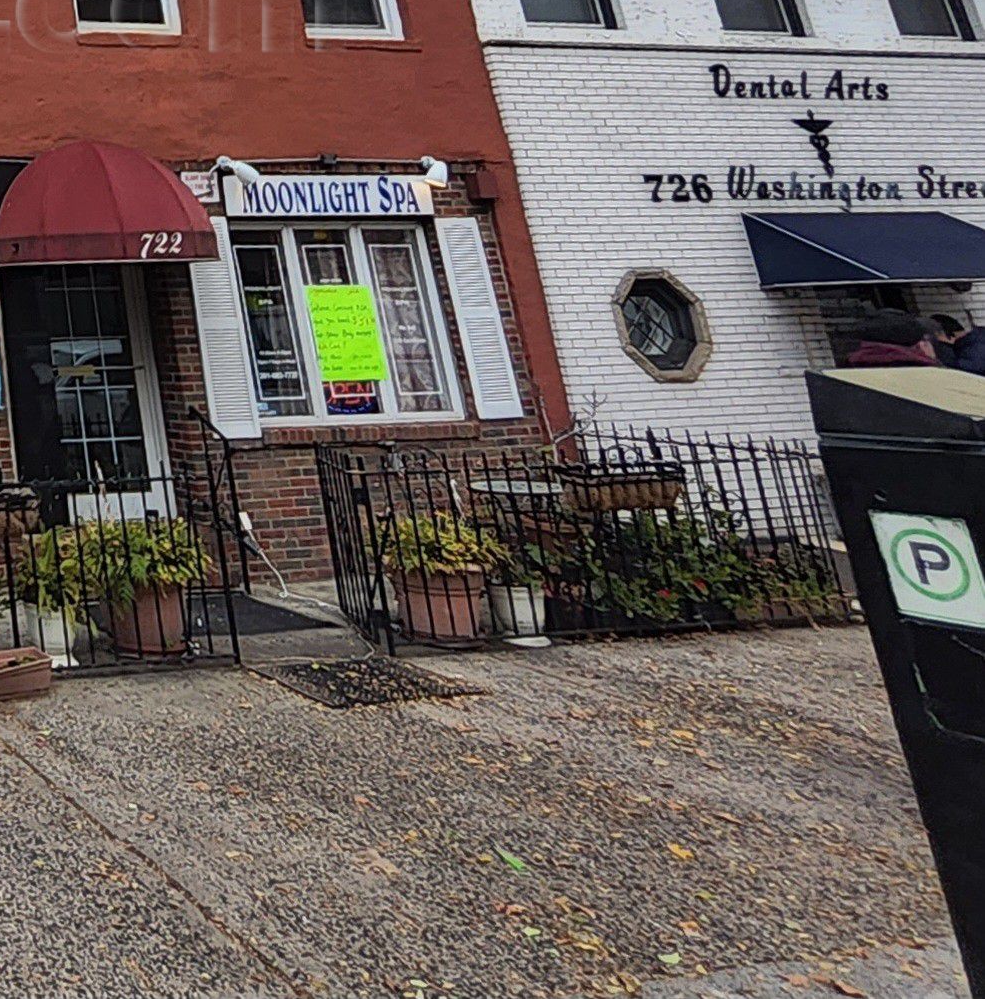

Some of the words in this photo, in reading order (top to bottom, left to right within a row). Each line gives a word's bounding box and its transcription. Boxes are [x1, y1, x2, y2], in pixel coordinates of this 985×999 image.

[709, 64, 811, 100] Dental
[824, 70, 890, 101] Arts
[242, 179, 370, 214] MOONLIGHT
[378, 175, 421, 213] SPA
[642, 174, 714, 204] 726
[727, 164, 903, 213] Washington
[140, 232, 183, 258] 722
[909, 541, 951, 585] P
